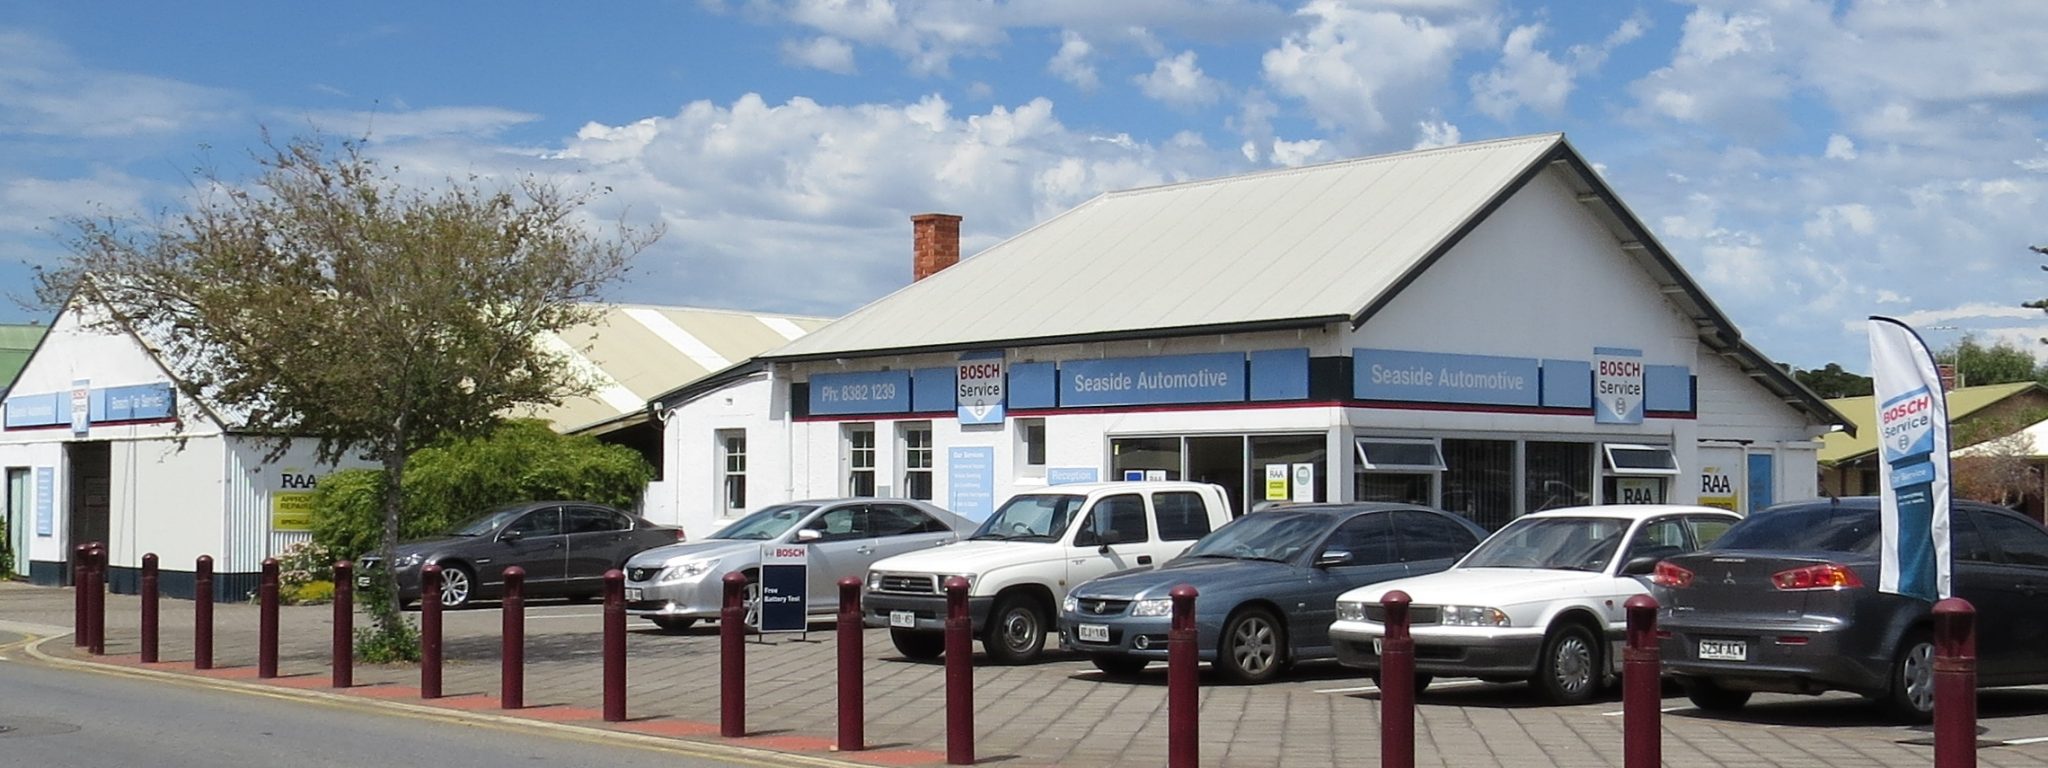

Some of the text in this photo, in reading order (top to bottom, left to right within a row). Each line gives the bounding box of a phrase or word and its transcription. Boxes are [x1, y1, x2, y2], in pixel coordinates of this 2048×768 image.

[960, 364, 1000, 380] BOSCH
[1371, 363, 1524, 391] Seaside Automotive
[1599, 360, 1641, 377] BOSCH
[1074, 367, 1228, 392] Seaside Automotive
[1599, 380, 1641, 396] Service
[823, 383, 896, 402] Ph: 8382 1239
[960, 383, 1000, 398] Service
[1883, 397, 1928, 424] BOSCH
[1885, 416, 1928, 438] Service
[281, 474, 317, 488] RAA
[1702, 474, 1731, 493] RAA
[1624, 488, 1652, 505] RAA
[776, 549, 805, 557] BOSCH
